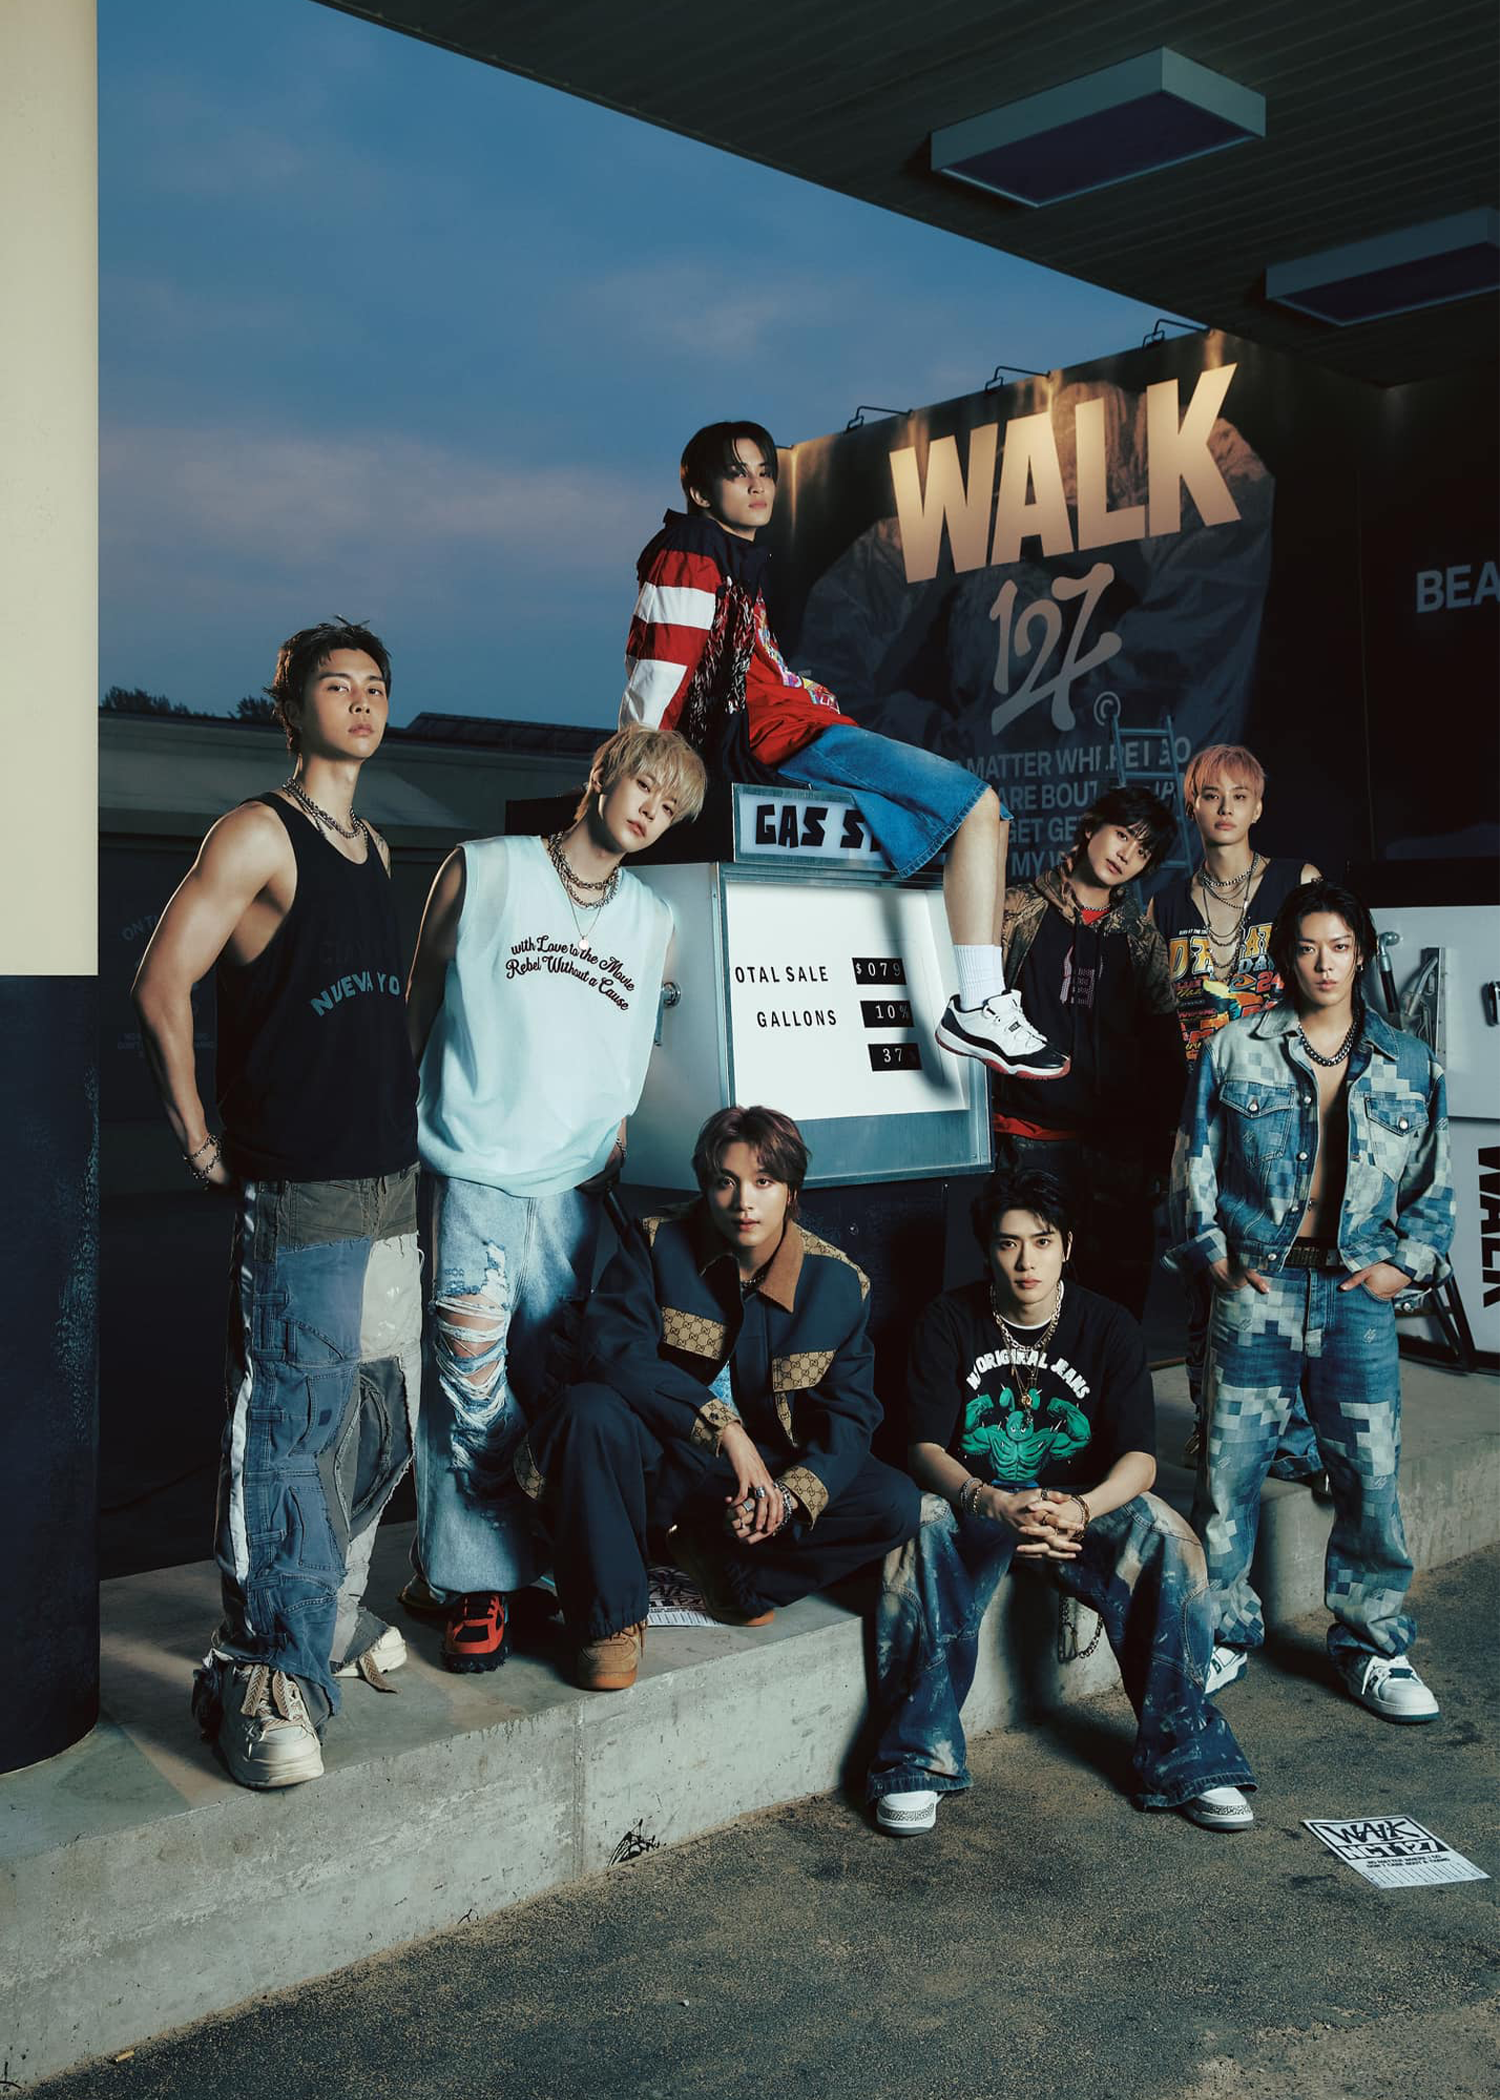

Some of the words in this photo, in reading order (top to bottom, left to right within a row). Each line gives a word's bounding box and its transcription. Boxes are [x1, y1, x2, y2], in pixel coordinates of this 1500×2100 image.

[889, 363, 1241, 584] WALK
[1416, 561, 1500, 614] BEA
[989, 562, 1122, 736] 127
[967, 750, 1052, 780] MATTER
[755, 804, 829, 848] GAS
[840, 809, 881, 852] S
[505, 957, 541, 979] Rebel
[541, 956, 589, 983] Without
[588, 976, 598, 987] a
[598, 976, 629, 1011] Cause
[511, 937, 536, 956] with
[536, 935, 568, 953] Love
[569, 943, 579, 957] to
[580, 947, 599, 964] the
[598, 956, 635, 992] Movie
[786, 965, 829, 982] SALE
[756, 1009, 837, 1027] GALLONS
[1050, 1357, 1091, 1399] JEANS
[1319, 1820, 1421, 1844] WALK
[1338, 1843, 1398, 1859] NCT
[1397, 1840, 1439, 1855] 127
